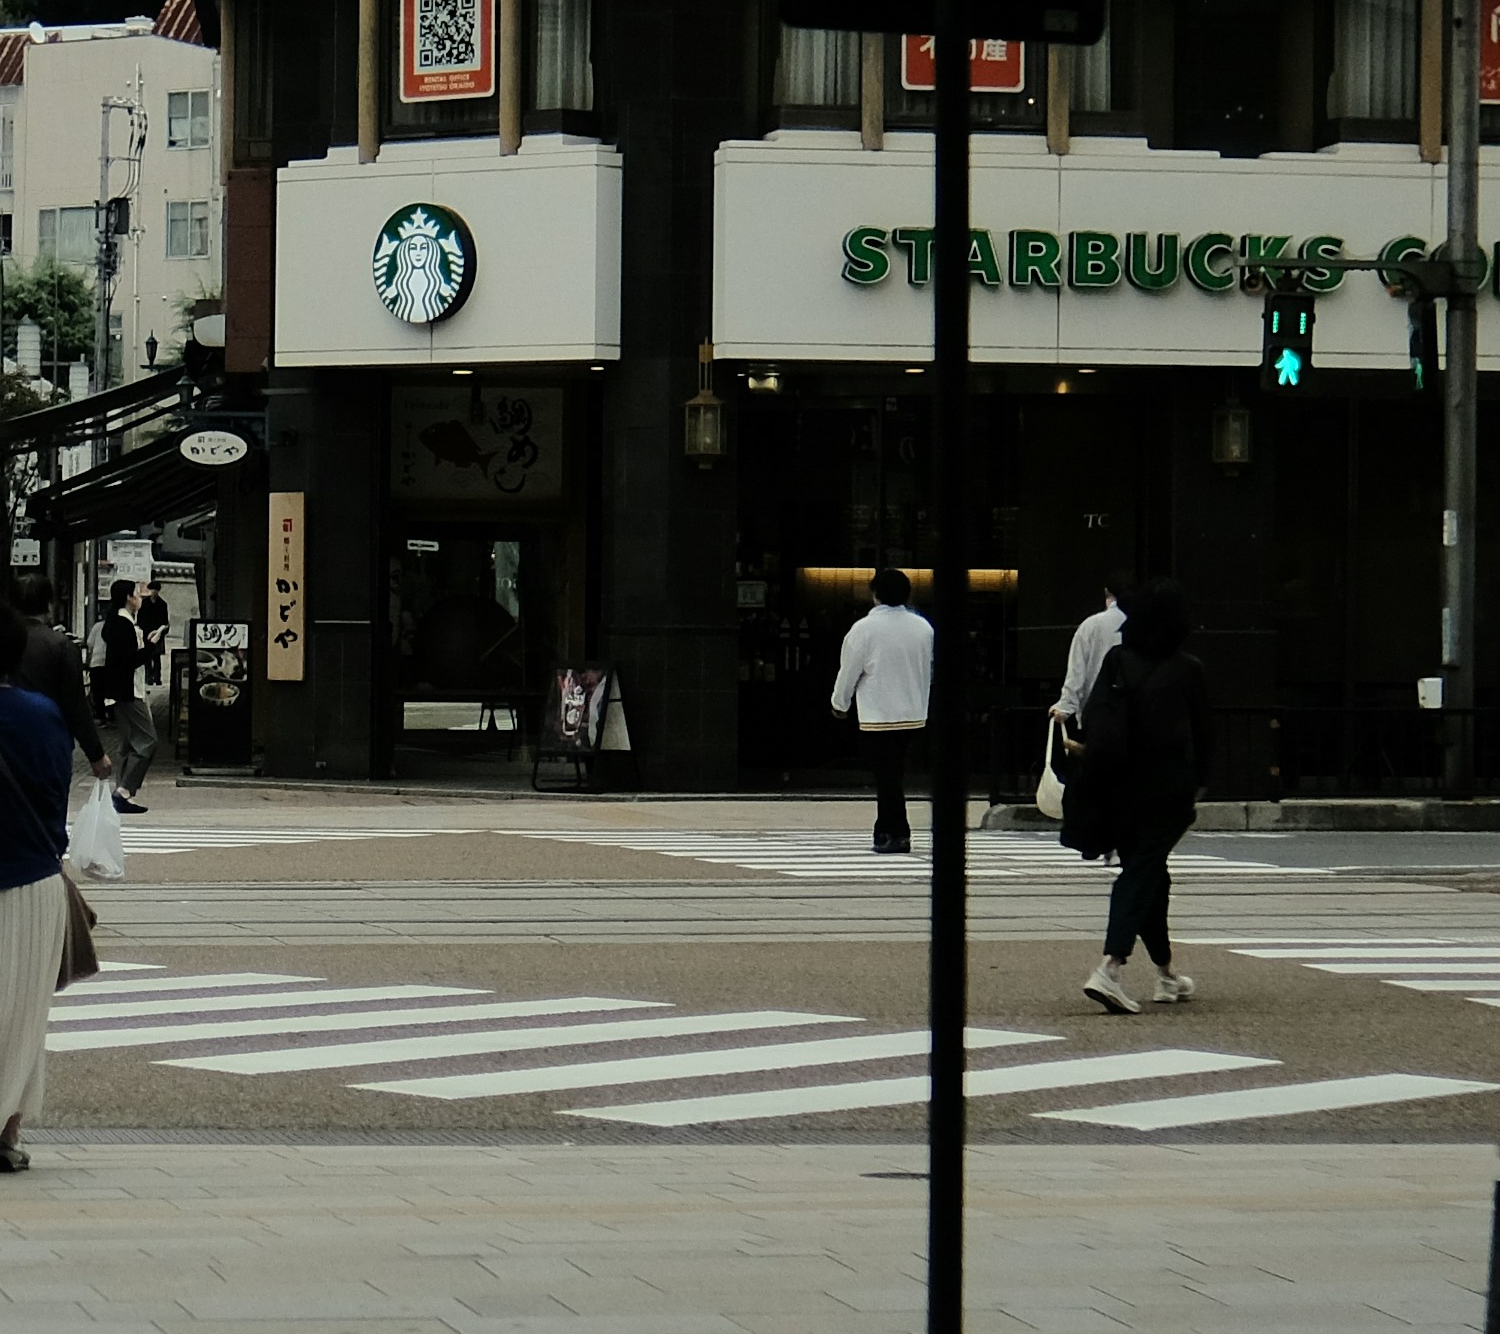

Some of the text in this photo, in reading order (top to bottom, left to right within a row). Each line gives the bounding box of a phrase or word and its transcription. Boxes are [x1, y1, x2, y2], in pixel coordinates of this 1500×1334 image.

[842, 224, 1346, 293] STARBUCKS
[190, 444, 240, 456] かどや
[13, 554, 39, 564] こまで
[274, 576, 299, 650] かどや
